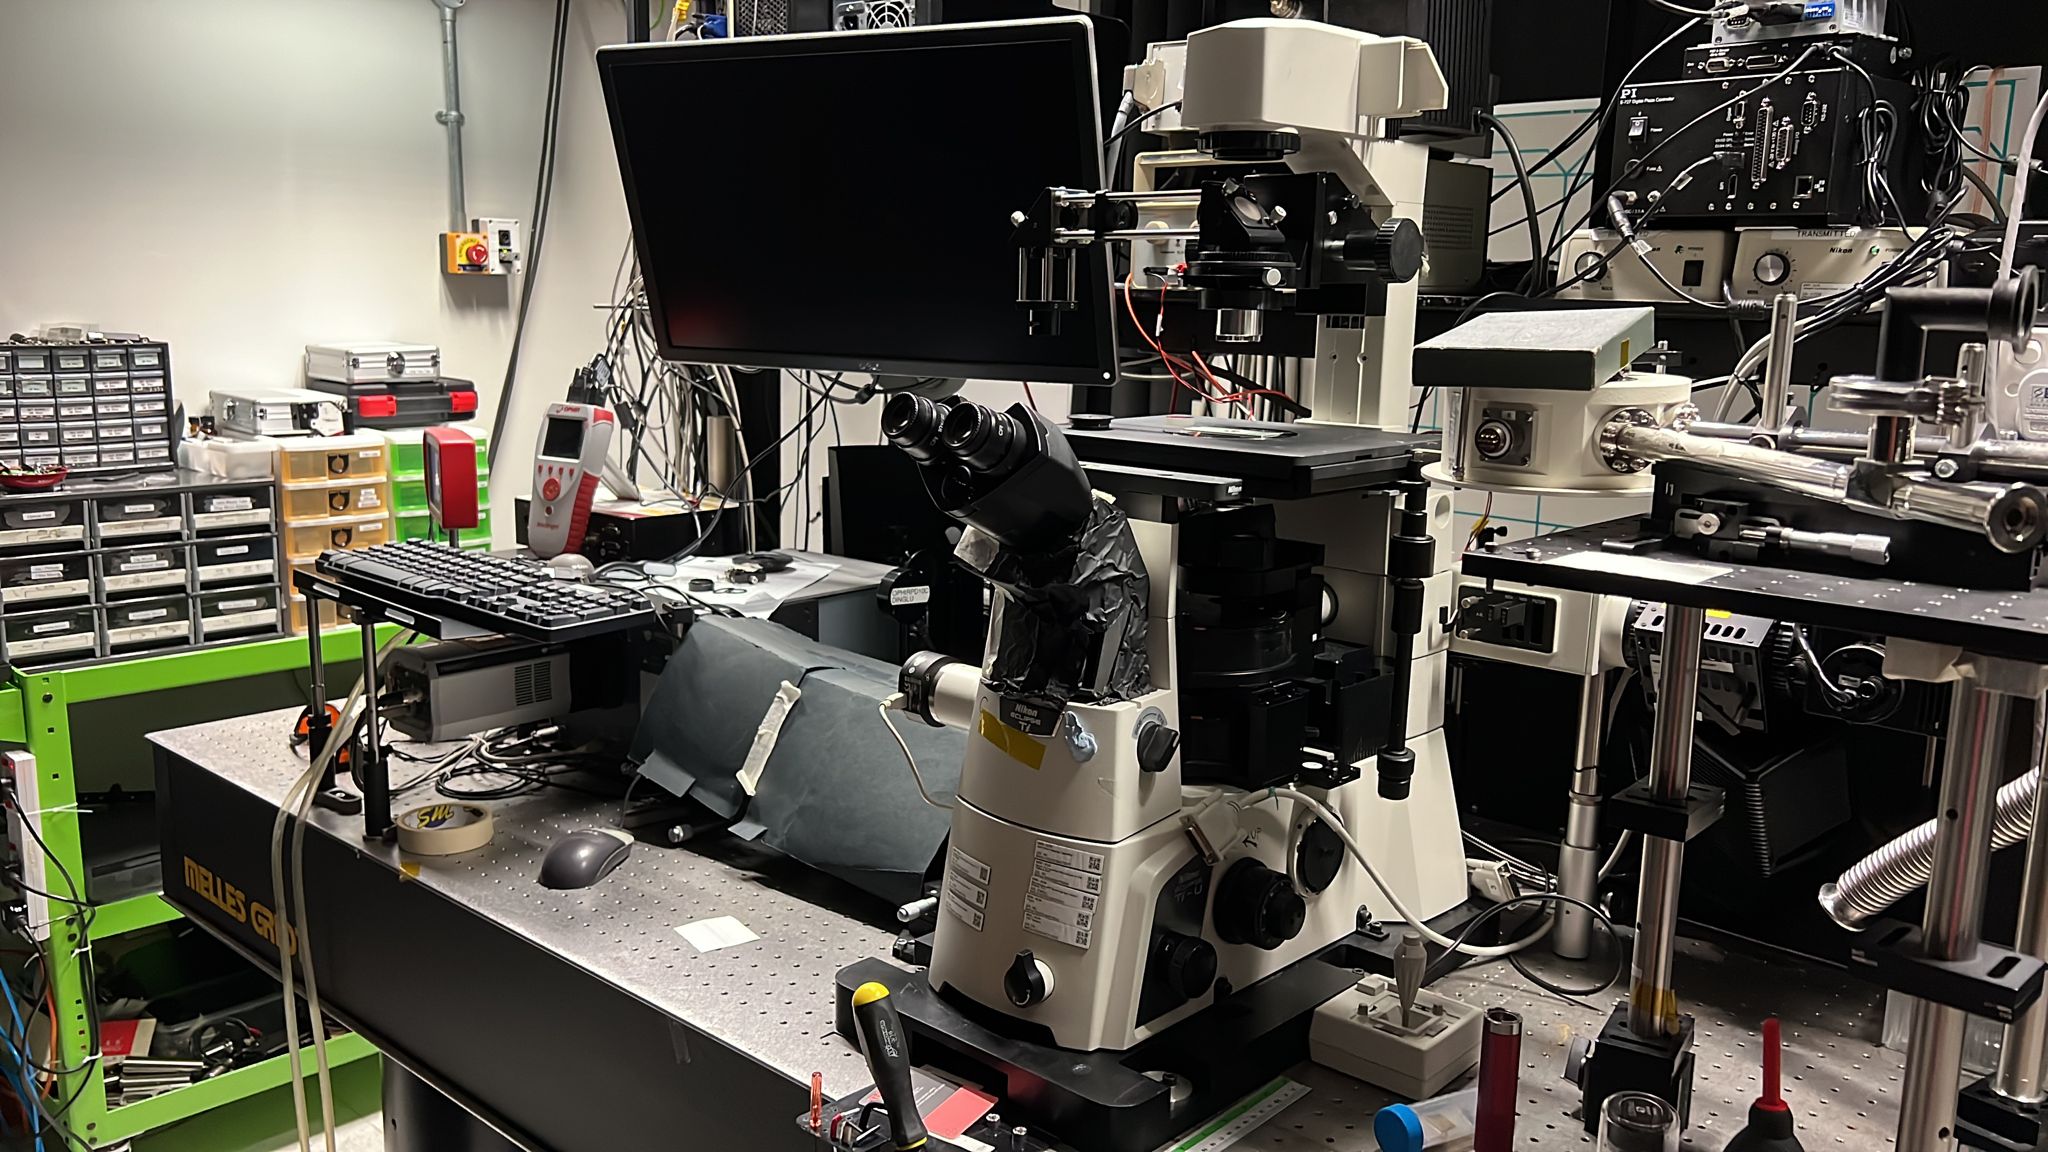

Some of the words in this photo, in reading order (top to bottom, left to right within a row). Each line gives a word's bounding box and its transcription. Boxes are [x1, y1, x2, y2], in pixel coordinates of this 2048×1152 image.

[1620, 88, 1638, 99] PI
[1797, 229, 1857, 239] TRANSMITTED
[1015, 703, 1038, 718] Nikon
[183, 855, 247, 924] MELLES
